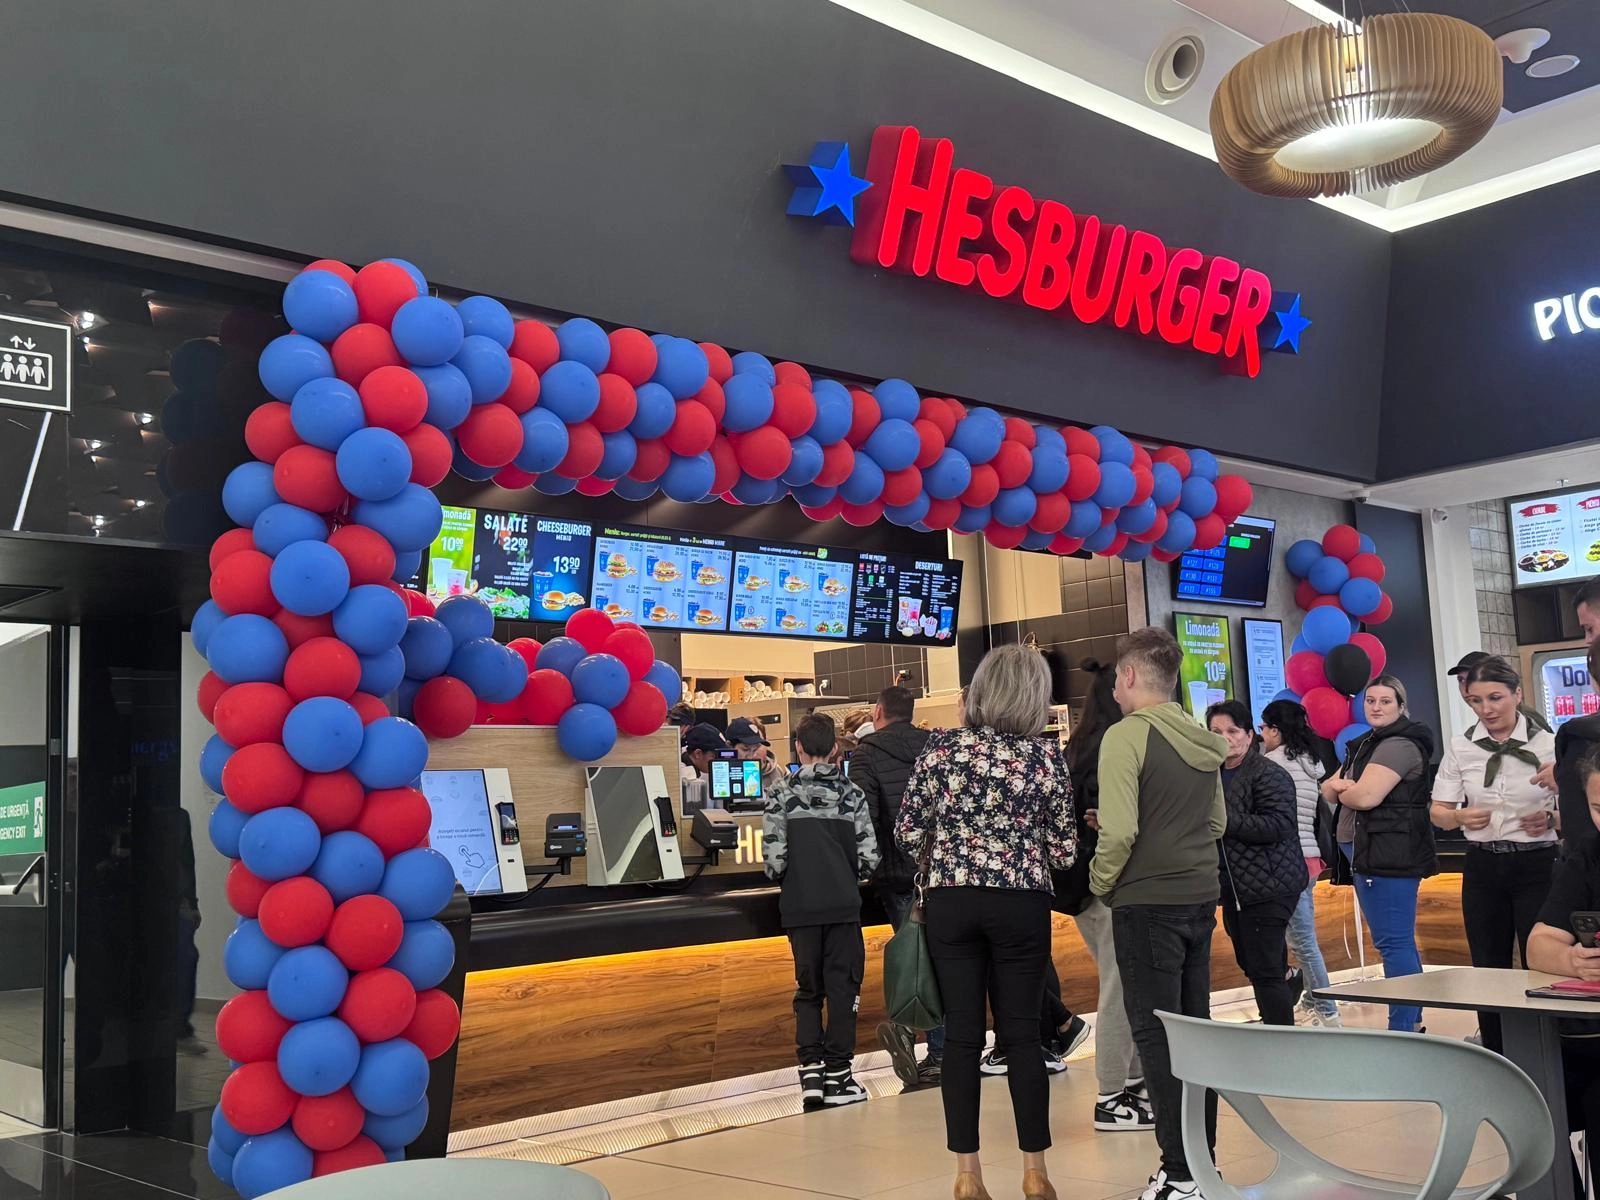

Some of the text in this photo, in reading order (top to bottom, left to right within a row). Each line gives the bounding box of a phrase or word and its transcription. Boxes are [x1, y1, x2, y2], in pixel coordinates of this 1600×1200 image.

[877, 125, 1272, 378] HESBURGER
[484, 514, 528, 533] SALATE
[537, 520, 592, 536] CHEESEBURGER
